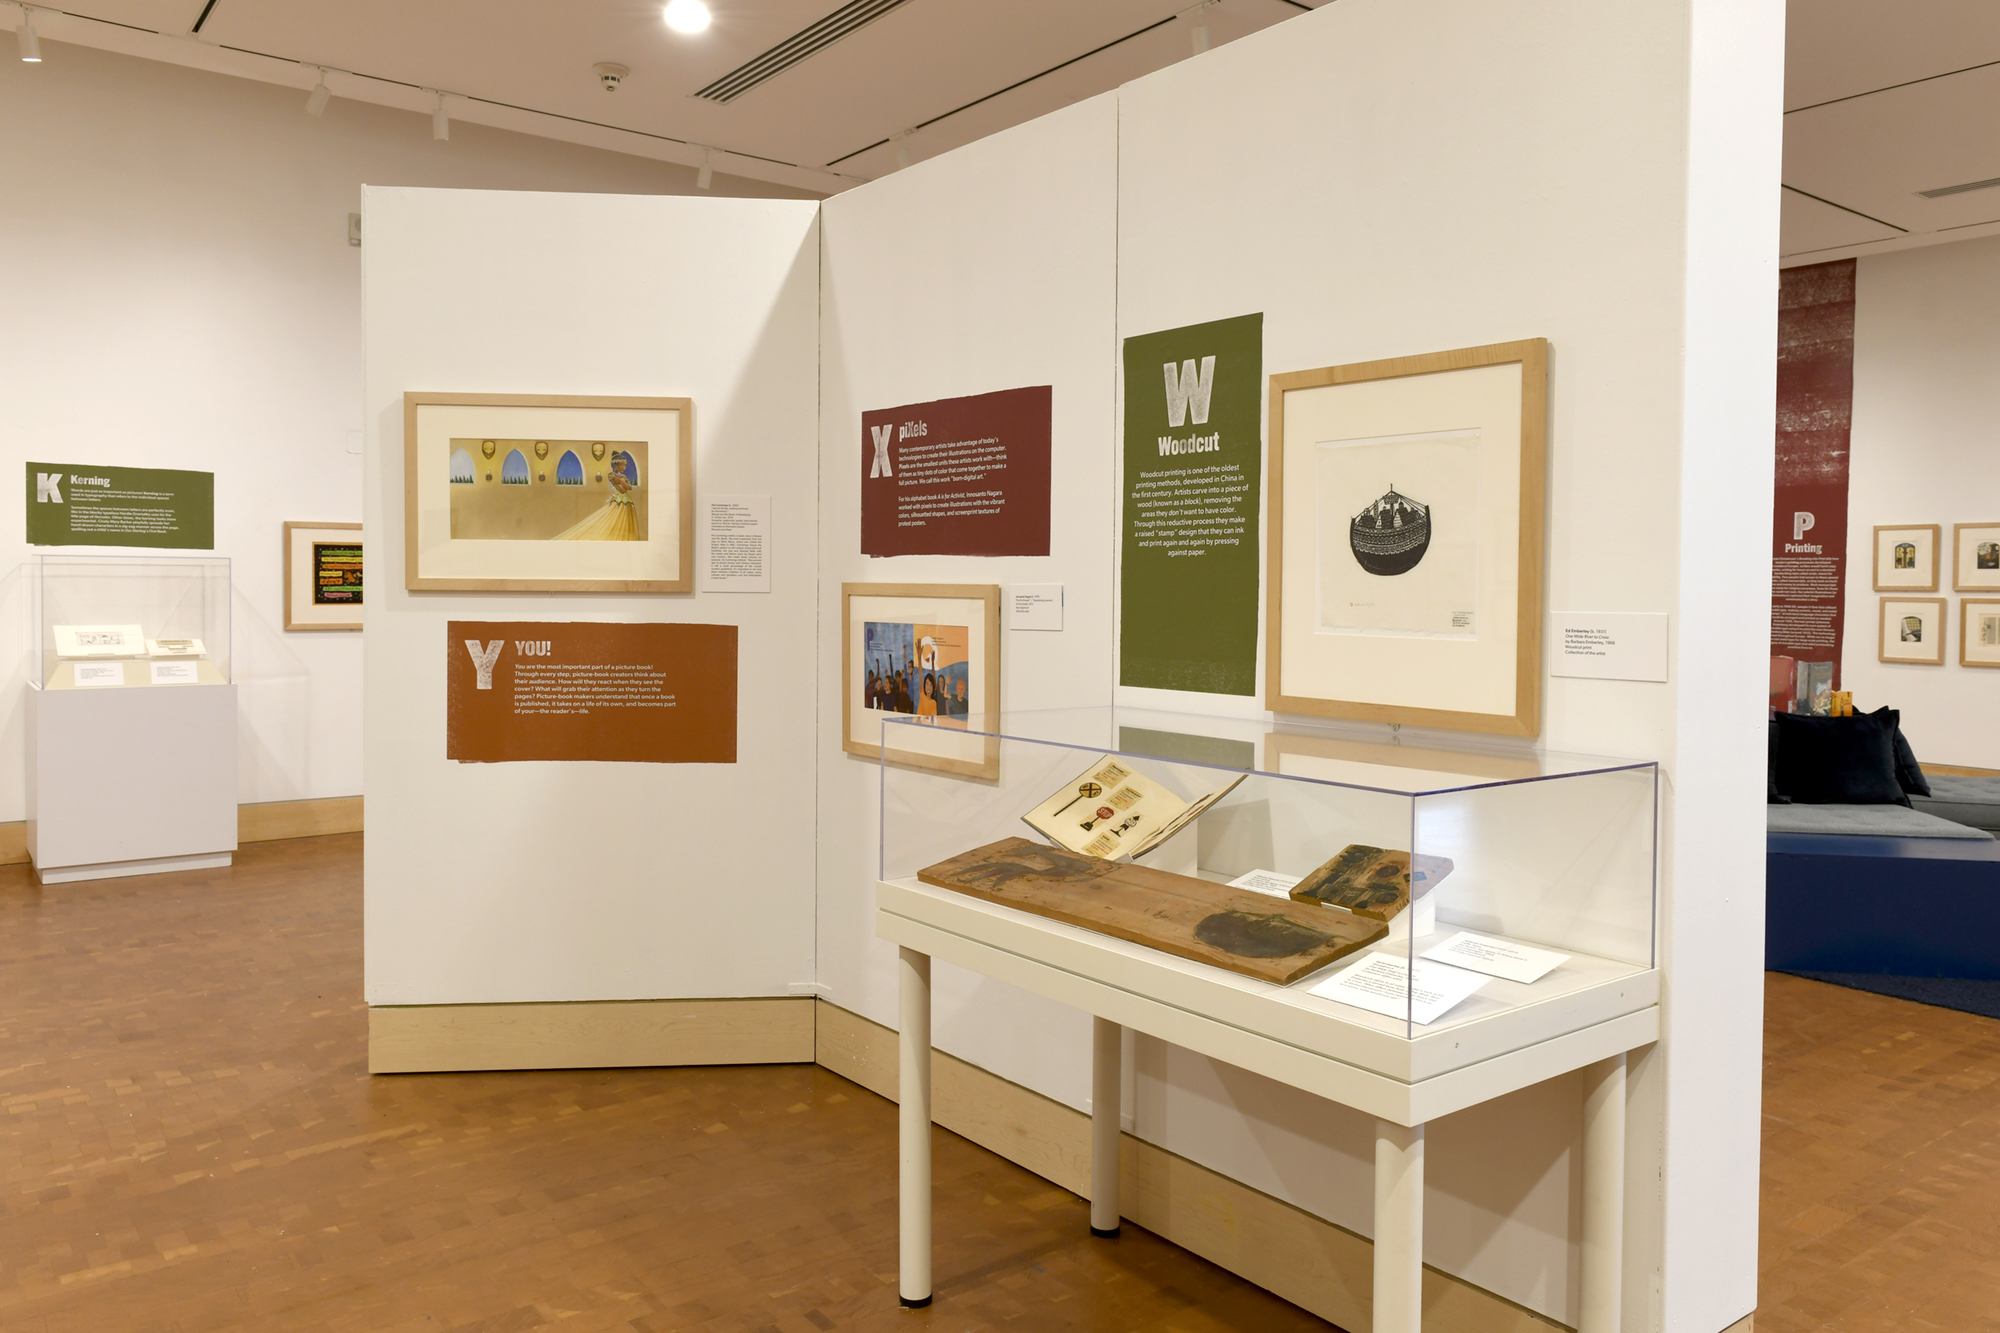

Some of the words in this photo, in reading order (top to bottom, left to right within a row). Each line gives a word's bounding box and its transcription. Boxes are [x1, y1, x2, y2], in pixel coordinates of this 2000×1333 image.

[1163, 355, 1216, 427] W
[899, 420, 927, 442] piXels
[870, 424, 893, 478] X
[1158, 432, 1220, 456] Woodcut
[1165, 469, 1186, 478] printing
[1221, 464, 1240, 472] oldest
[37, 473, 63, 503] K
[70, 475, 110, 487] Kerning
[1136, 481, 1157, 490] printing
[1183, 476, 1214, 485] developed
[1225, 485, 1242, 493] piece
[1204, 496, 1232, 504] removing
[1156, 510, 1168, 518] they
[1134, 520, 1156, 529] Through
[1215, 517, 1229, 525] they
[1793, 512, 1815, 540] P
[1178, 529, 1198, 537] design
[1210, 528, 1223, 536] they
[1149, 540, 1162, 548] print
[1163, 539, 1178, 548] again
[1190, 538, 1206, 547] again
[1206, 538, 1214, 546] by
[1214, 538, 1240, 546] pressing
[1785, 543, 1822, 554] Printing
[1168, 549, 1188, 557] against
[515, 641, 551, 656] YOU!
[465, 640, 505, 689] Y
